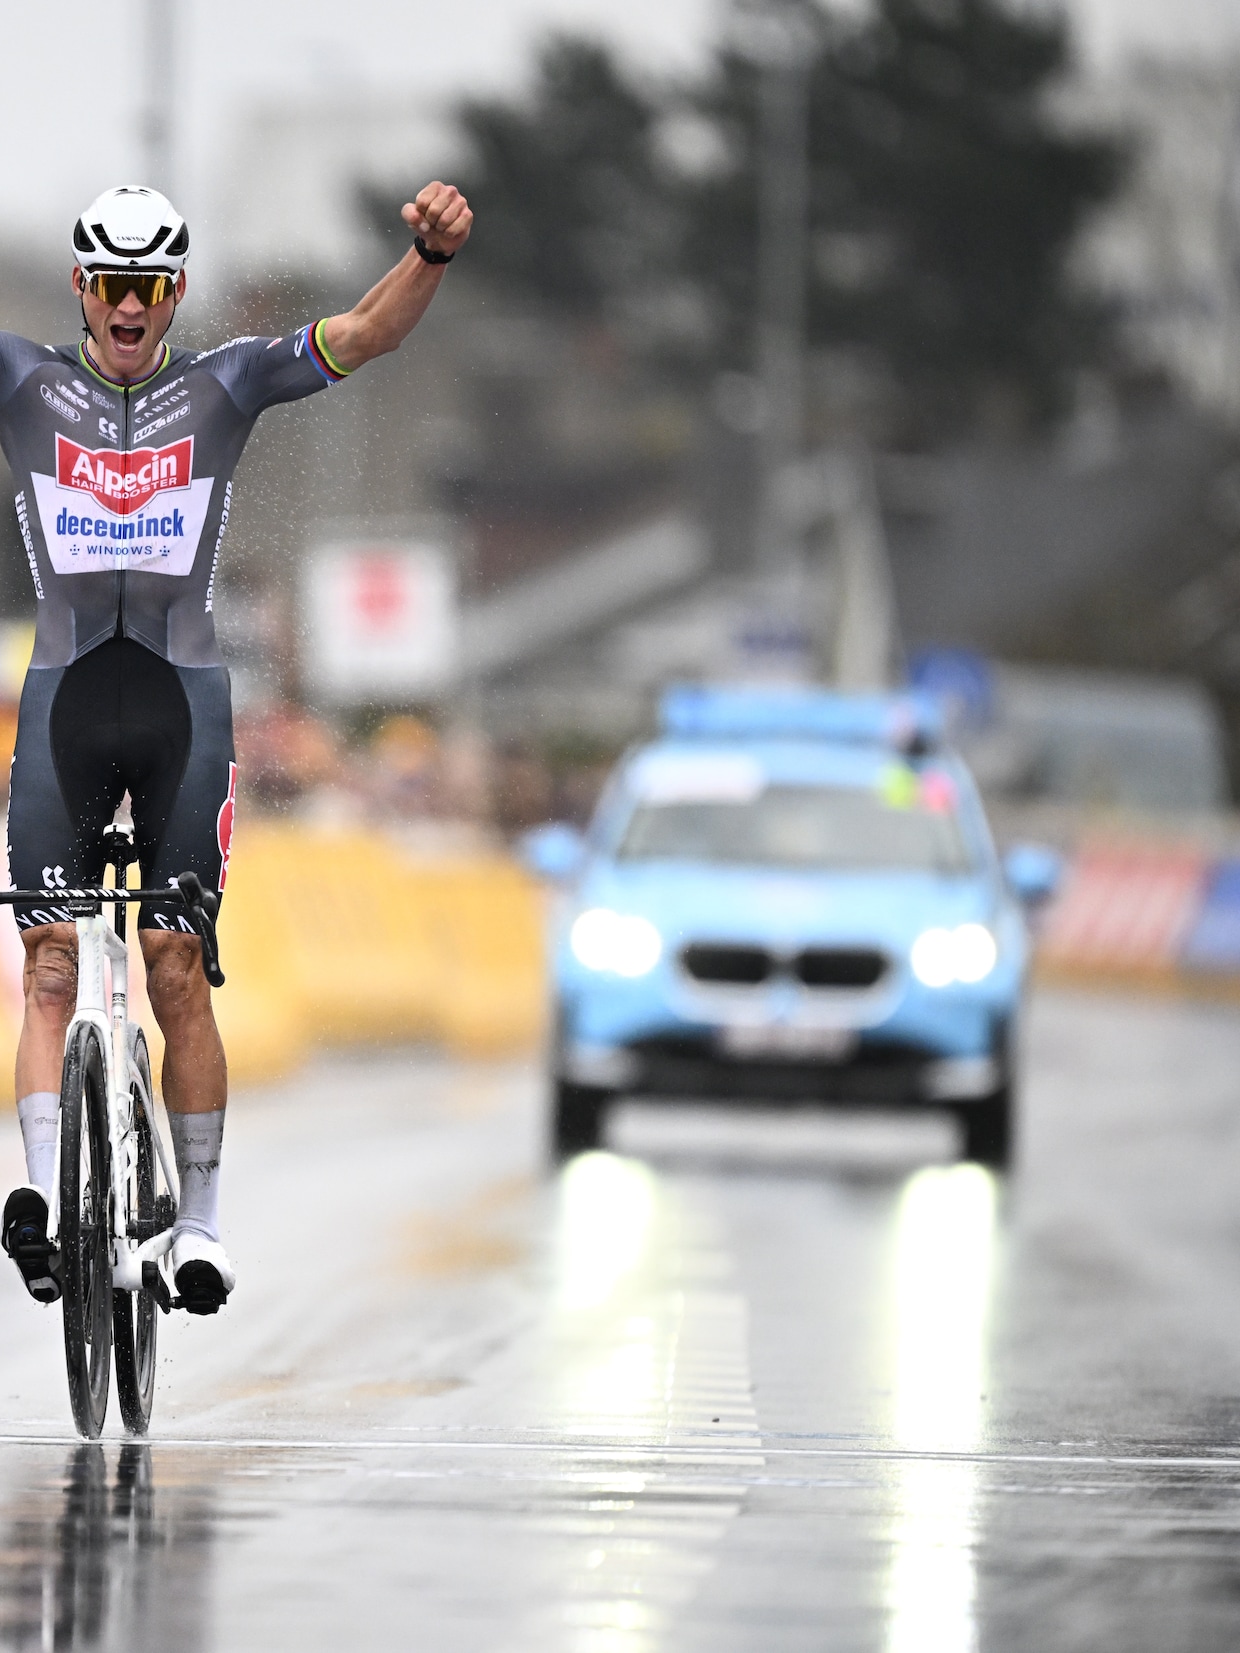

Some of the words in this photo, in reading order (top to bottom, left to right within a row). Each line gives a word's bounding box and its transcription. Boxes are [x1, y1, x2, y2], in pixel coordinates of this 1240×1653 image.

[151, 376, 185, 401] ZWIFT
[44, 391, 76, 418] ABUS
[134, 389, 189, 424] CANYON
[135, 404, 189, 440] LUXAUTO
[71, 452, 177, 496] Alpecin
[71, 477, 104, 493] HAIR
[113, 477, 177, 499] BOOSTER
[56, 507, 184, 539] deceuninck
[87, 545, 153, 555] WINDOWS
[38, 889, 131, 898] CANYON
